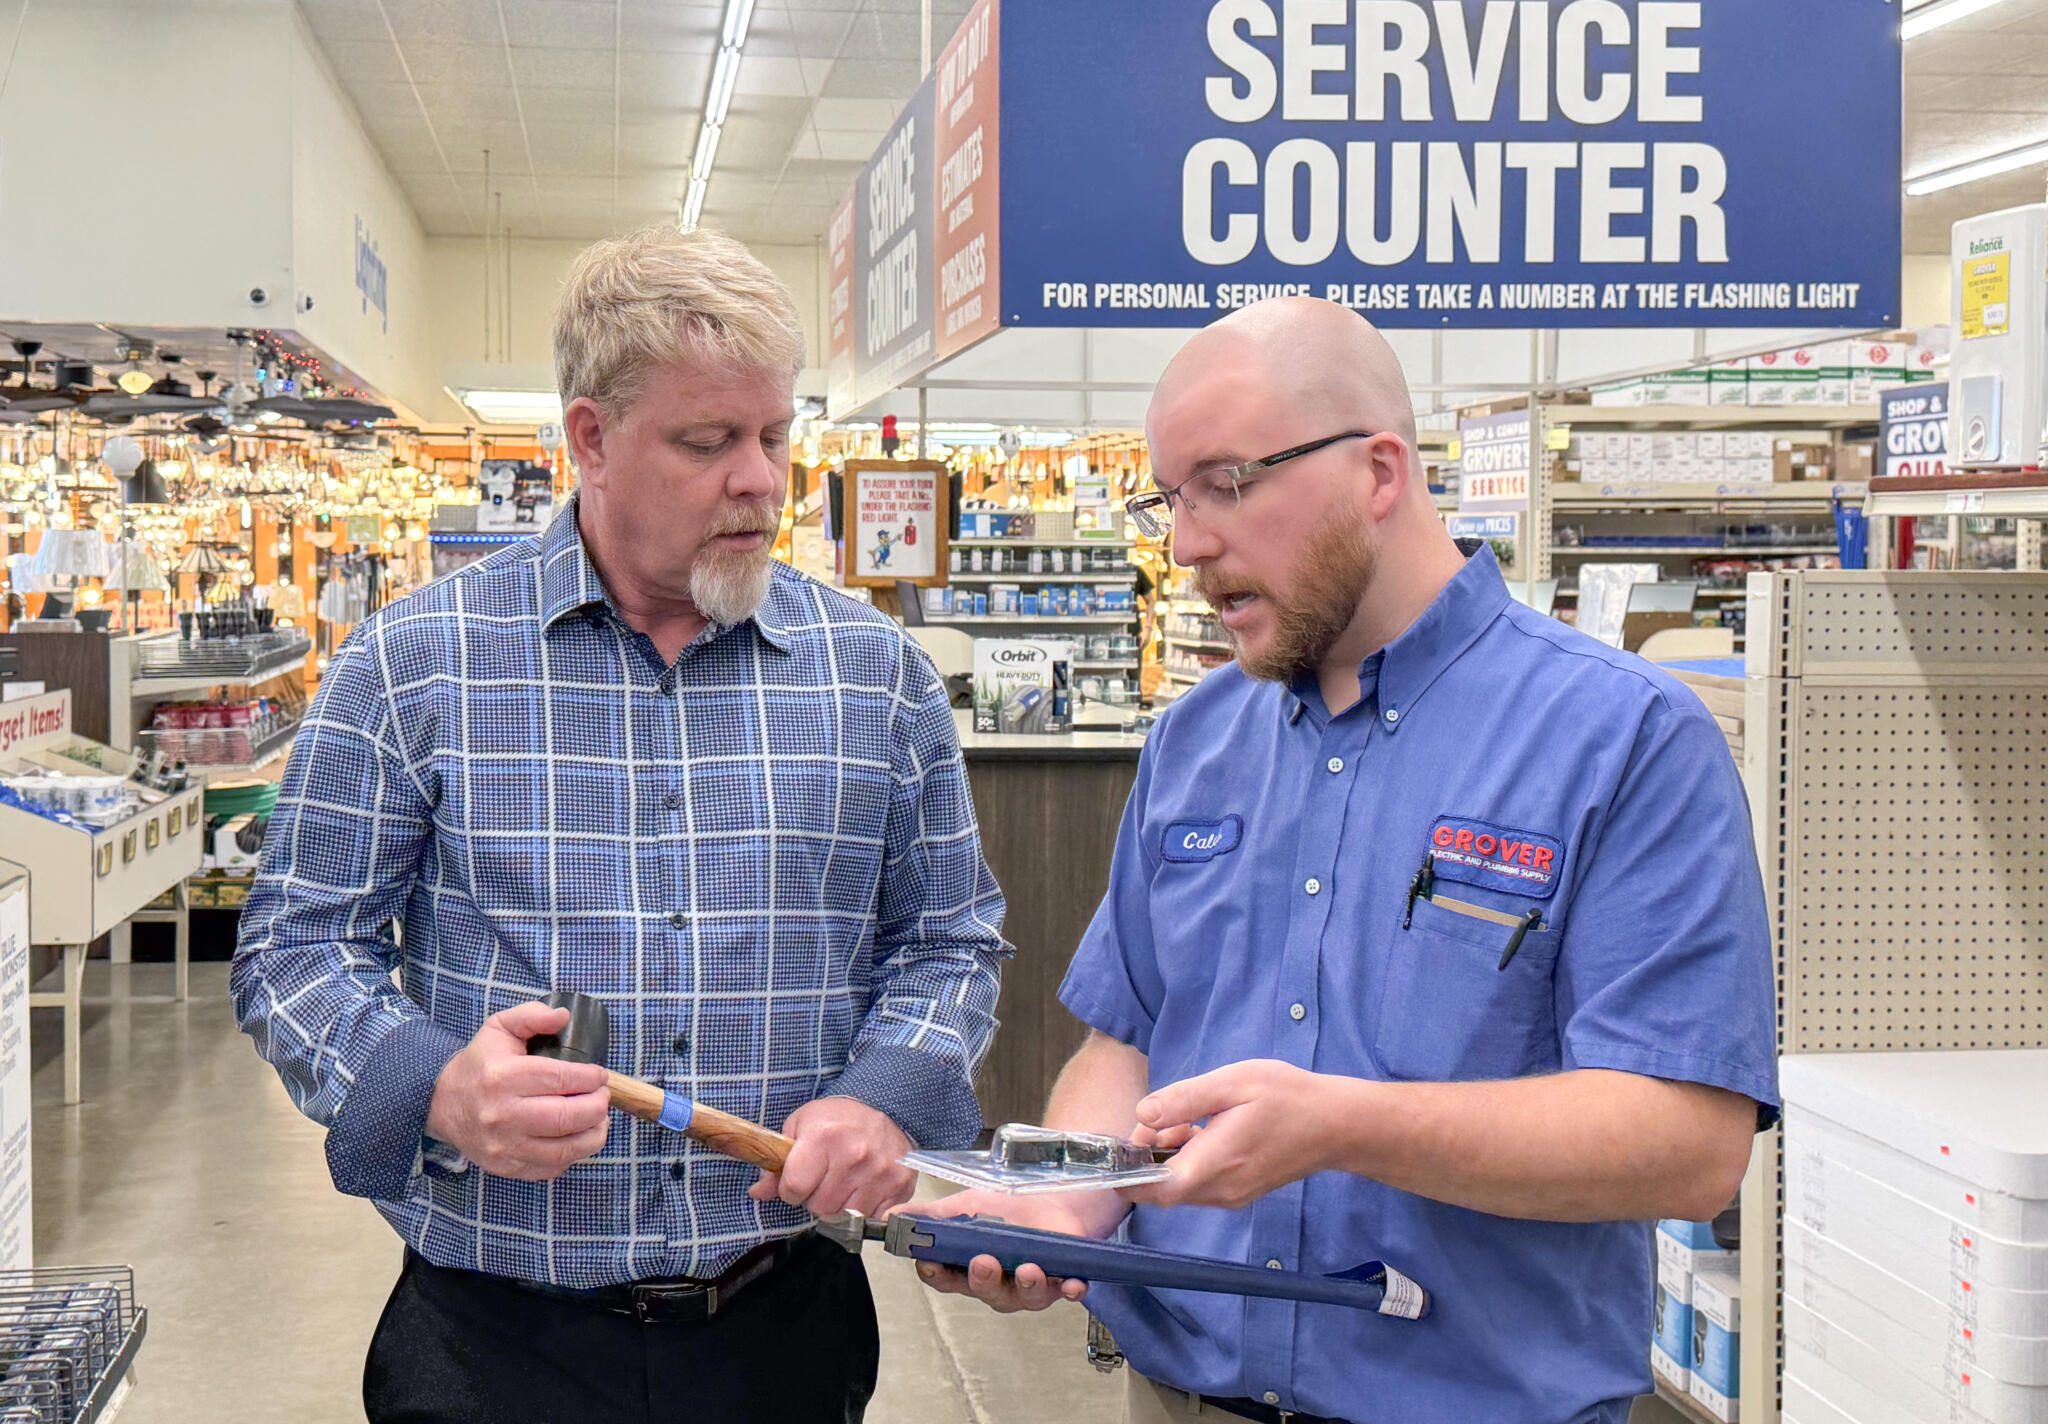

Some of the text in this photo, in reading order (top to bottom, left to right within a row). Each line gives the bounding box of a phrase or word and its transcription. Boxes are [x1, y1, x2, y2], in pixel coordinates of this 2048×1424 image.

[1205, 0, 1703, 125] SERVICE
[869, 116, 915, 259] SERVICE
[1182, 138, 1729, 266] COUNTER
[1969, 238, 2003, 256] Reliance
[867, 228, 918, 358] COUNTER
[1043, 283, 1088, 308] FOR
[1095, 283, 1211, 308] PERSONAL
[1327, 284, 1409, 308] PLEASE
[1416, 284, 1471, 308] TAKE
[1477, 284, 1495, 308] A
[1500, 284, 1596, 308] NUMBER
[1601, 284, 1630, 308] AT
[1634, 284, 1681, 308] THE
[1684, 284, 1791, 308] FLASHING
[1796, 284, 1861, 308] LIGHT
[1888, 396, 1942, 417] SHOP &
[1471, 475, 1525, 497] SERVICE
[1001, 649, 1036, 661] Orbit
[996, 671, 1041, 680] HEAVY DUTY
[28, 698, 66, 737] Items!
[1433, 825, 1554, 872] GROVER
[1464, 856, 1482, 866] AND
[1483, 860, 1520, 876] PLUMBING
[1520, 866, 1552, 882] SUPPLY
